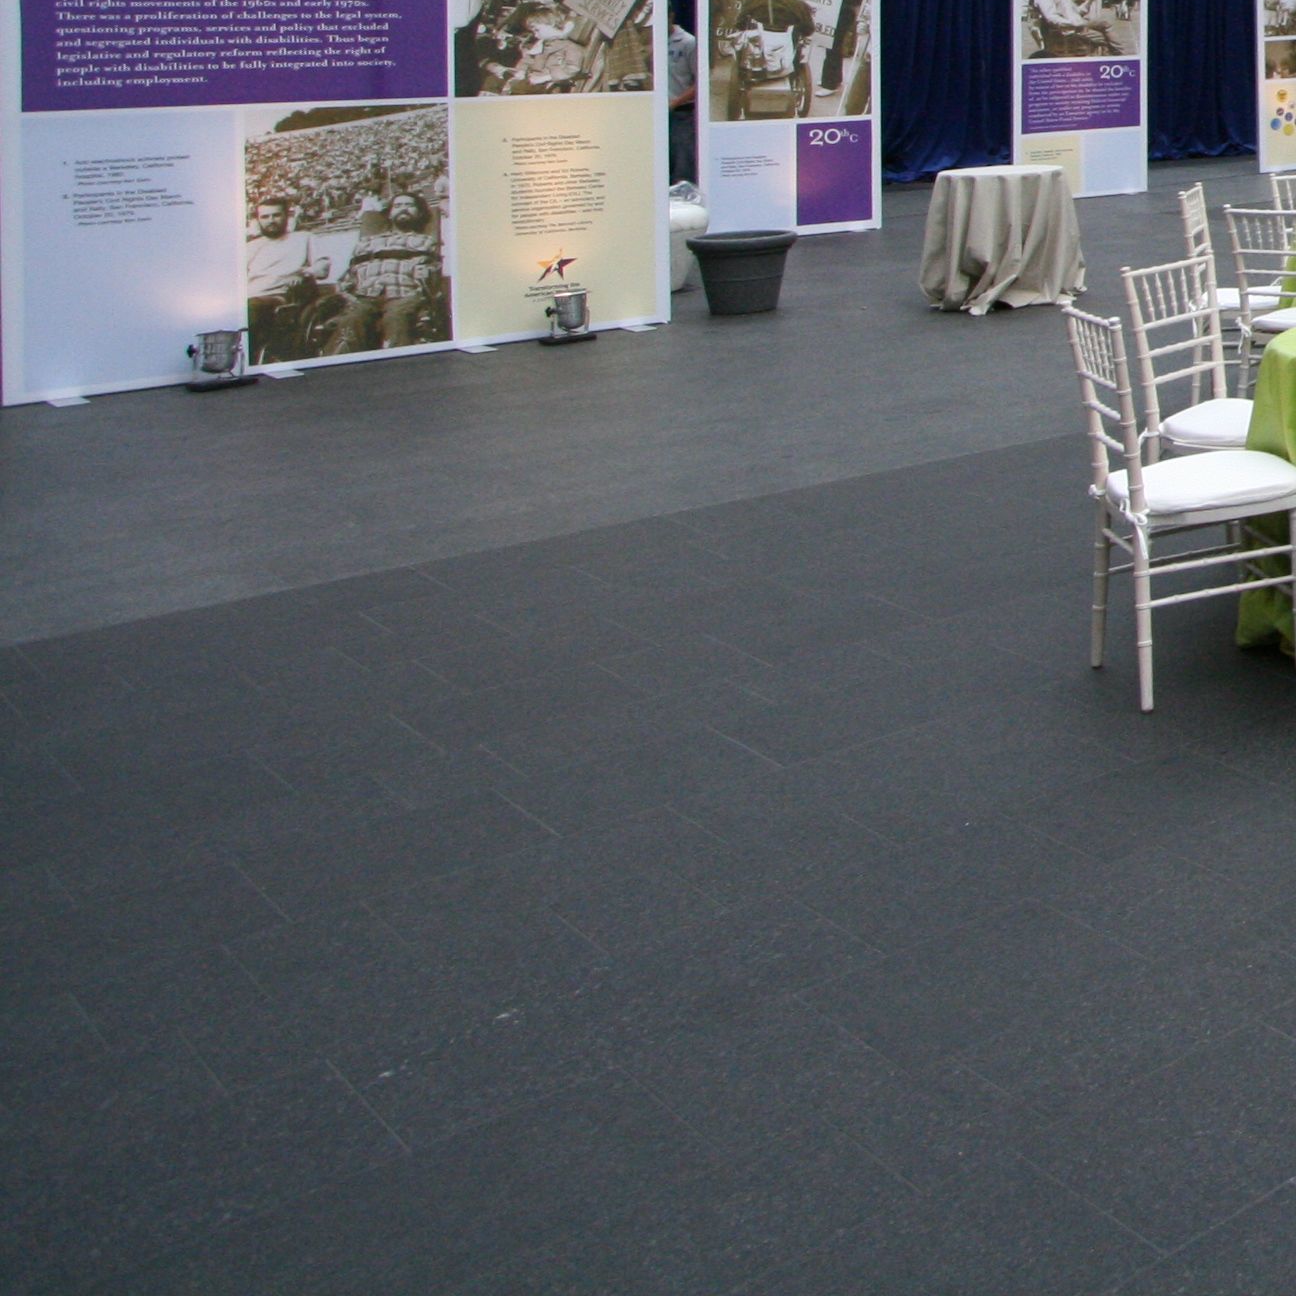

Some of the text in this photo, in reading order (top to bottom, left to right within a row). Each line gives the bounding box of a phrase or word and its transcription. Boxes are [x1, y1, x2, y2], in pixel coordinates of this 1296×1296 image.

[56, 0, 84, 8] civil
[89, 0, 126, 10] rights
[130, 0, 200, 8] movements
[204, 0, 218, 8] of
[220, 0, 239, 8] the
[280, 0, 301, 7] and
[304, 0, 332, 9] early
[56, 12, 96, 21] There
[100, 13, 121, 21] was
[135, 11, 218, 22] proliferation
[221, 11, 234, 20] of
[236, 11, 298, 21] challenges
[301, 12, 312, 20] to
[315, 11, 332, 20] the
[336, 11, 361, 21] legal
[56, 25, 136, 36] questioning
[205, 24, 250, 33] services
[254, 23, 277, 32] and
[280, 23, 314, 34] policy
[317, 23, 338, 31] that
[341, 23, 389, 31] excluded
[56, 35, 389, 48] and segregated individuals with disabilities. Thus began
[57, 46, 387, 62] legislative and regulatory reform reflecting the right of
[57, 64, 101, 76] people
[104, 63, 131, 72] with
[134, 62, 205, 73] disabilities
[207, 63, 219, 71] to
[222, 62, 237, 71] be
[240, 60, 267, 71] fully
[271, 59, 329, 71] integrated
[331, 59, 355, 68] into
[57, 75, 208, 88] including employment.
